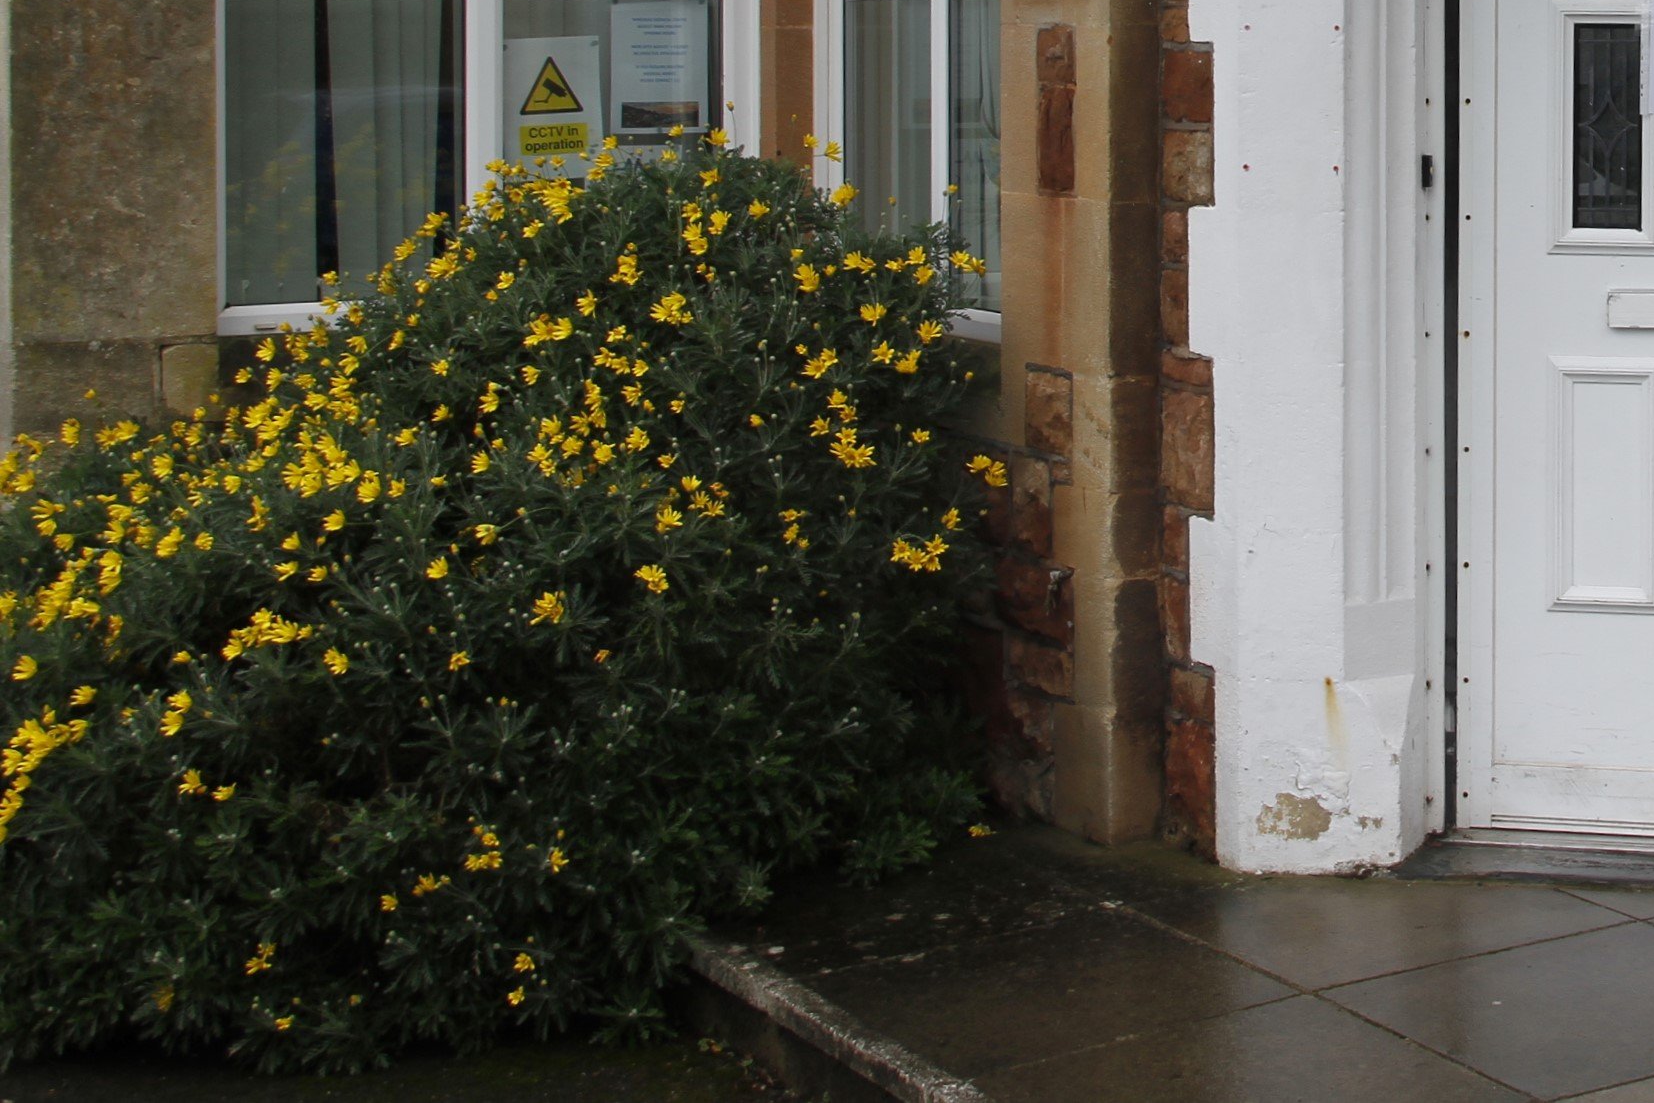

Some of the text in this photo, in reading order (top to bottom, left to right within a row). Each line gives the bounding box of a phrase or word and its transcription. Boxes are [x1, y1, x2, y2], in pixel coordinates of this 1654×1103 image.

[528, 125, 579, 139] CCTV in
[525, 137, 584, 152] operation
